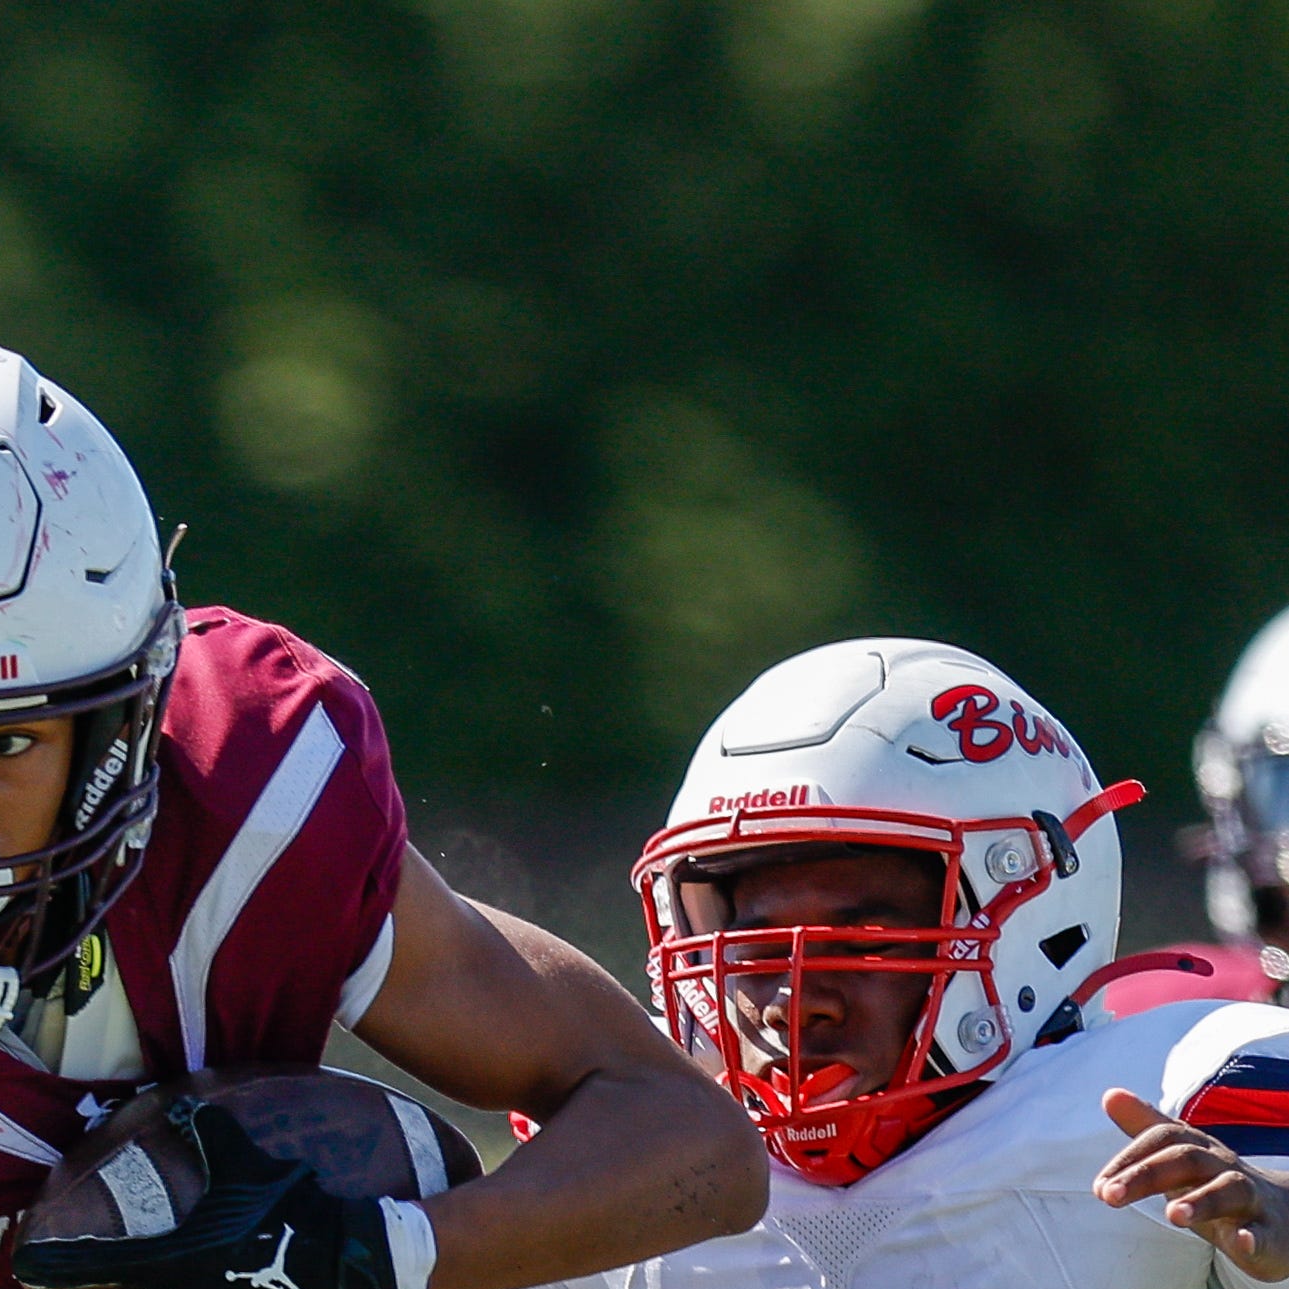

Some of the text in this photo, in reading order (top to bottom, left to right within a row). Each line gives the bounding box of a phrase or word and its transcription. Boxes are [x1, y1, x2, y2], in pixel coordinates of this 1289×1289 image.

[74, 738, 129, 832] Riddell
[709, 784, 808, 815] Riddell
[674, 977, 720, 1030] ddell
[787, 1122, 838, 1142] Riddell
